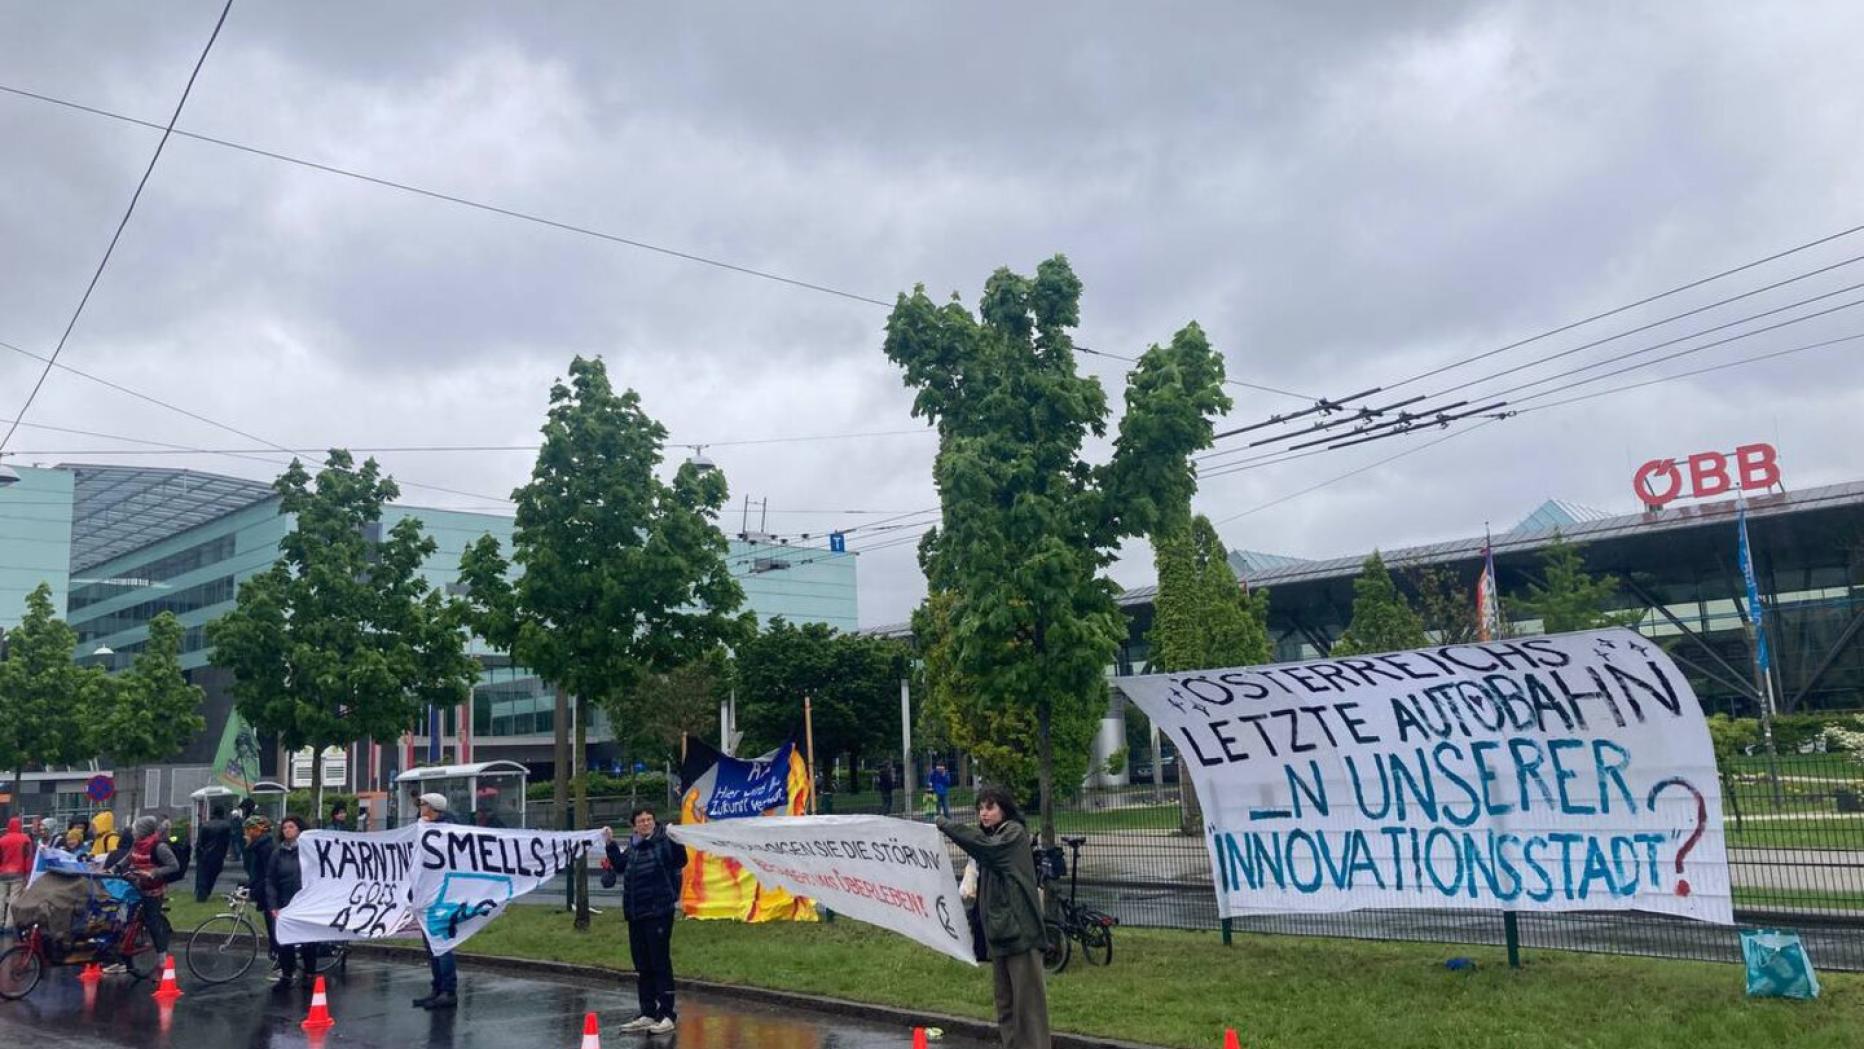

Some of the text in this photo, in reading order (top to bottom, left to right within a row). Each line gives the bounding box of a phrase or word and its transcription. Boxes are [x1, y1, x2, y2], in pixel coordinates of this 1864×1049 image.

[1634, 443, 1780, 505] ÖBB
[1181, 640, 1569, 706] ÖSTERREICHS
[1180, 662, 1681, 766] LETZTE AUTOBAHN
[1345, 738, 1637, 827] UNSERER
[421, 829, 545, 877] SMELLS
[814, 840, 843, 858] SIE
[841, 840, 872, 860] DIE
[871, 837, 940, 870] STÖRUN
[349, 881, 396, 906] GOES
